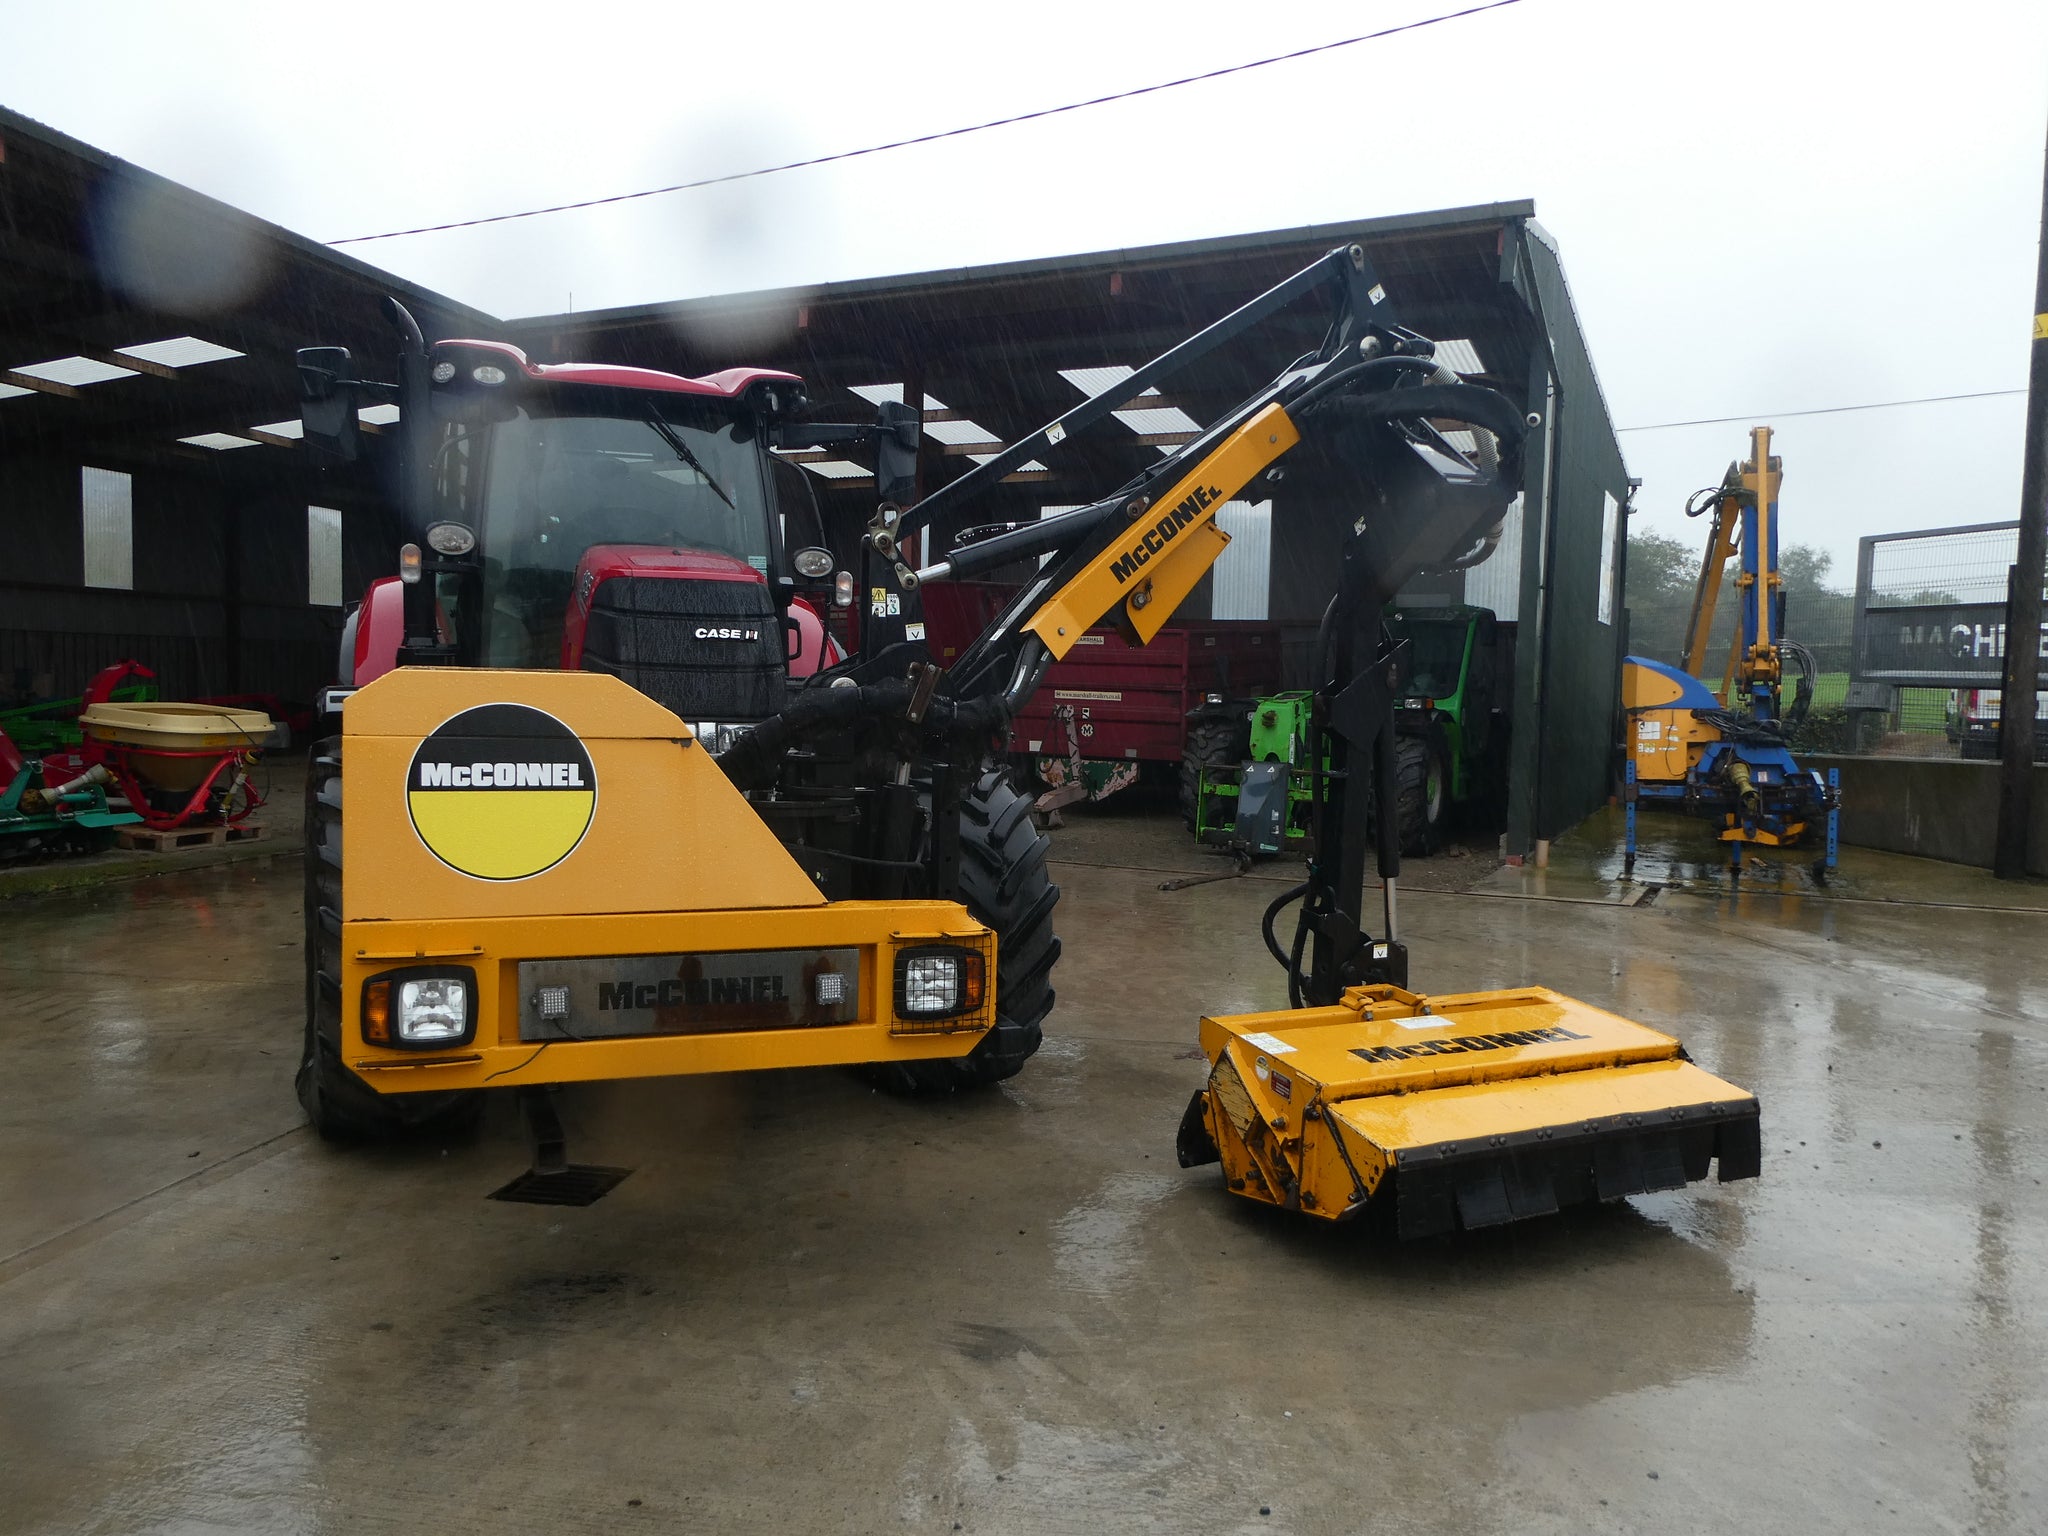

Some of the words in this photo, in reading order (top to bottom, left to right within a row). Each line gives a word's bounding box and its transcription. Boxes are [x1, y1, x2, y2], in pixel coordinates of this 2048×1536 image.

[1109, 485, 1222, 584] McCONNEL
[695, 627, 741, 639] CASE
[421, 763, 584, 787] McCONNEL
[599, 976, 790, 1010] McCONNEL
[1347, 1027, 1592, 1063] McCONNEL
